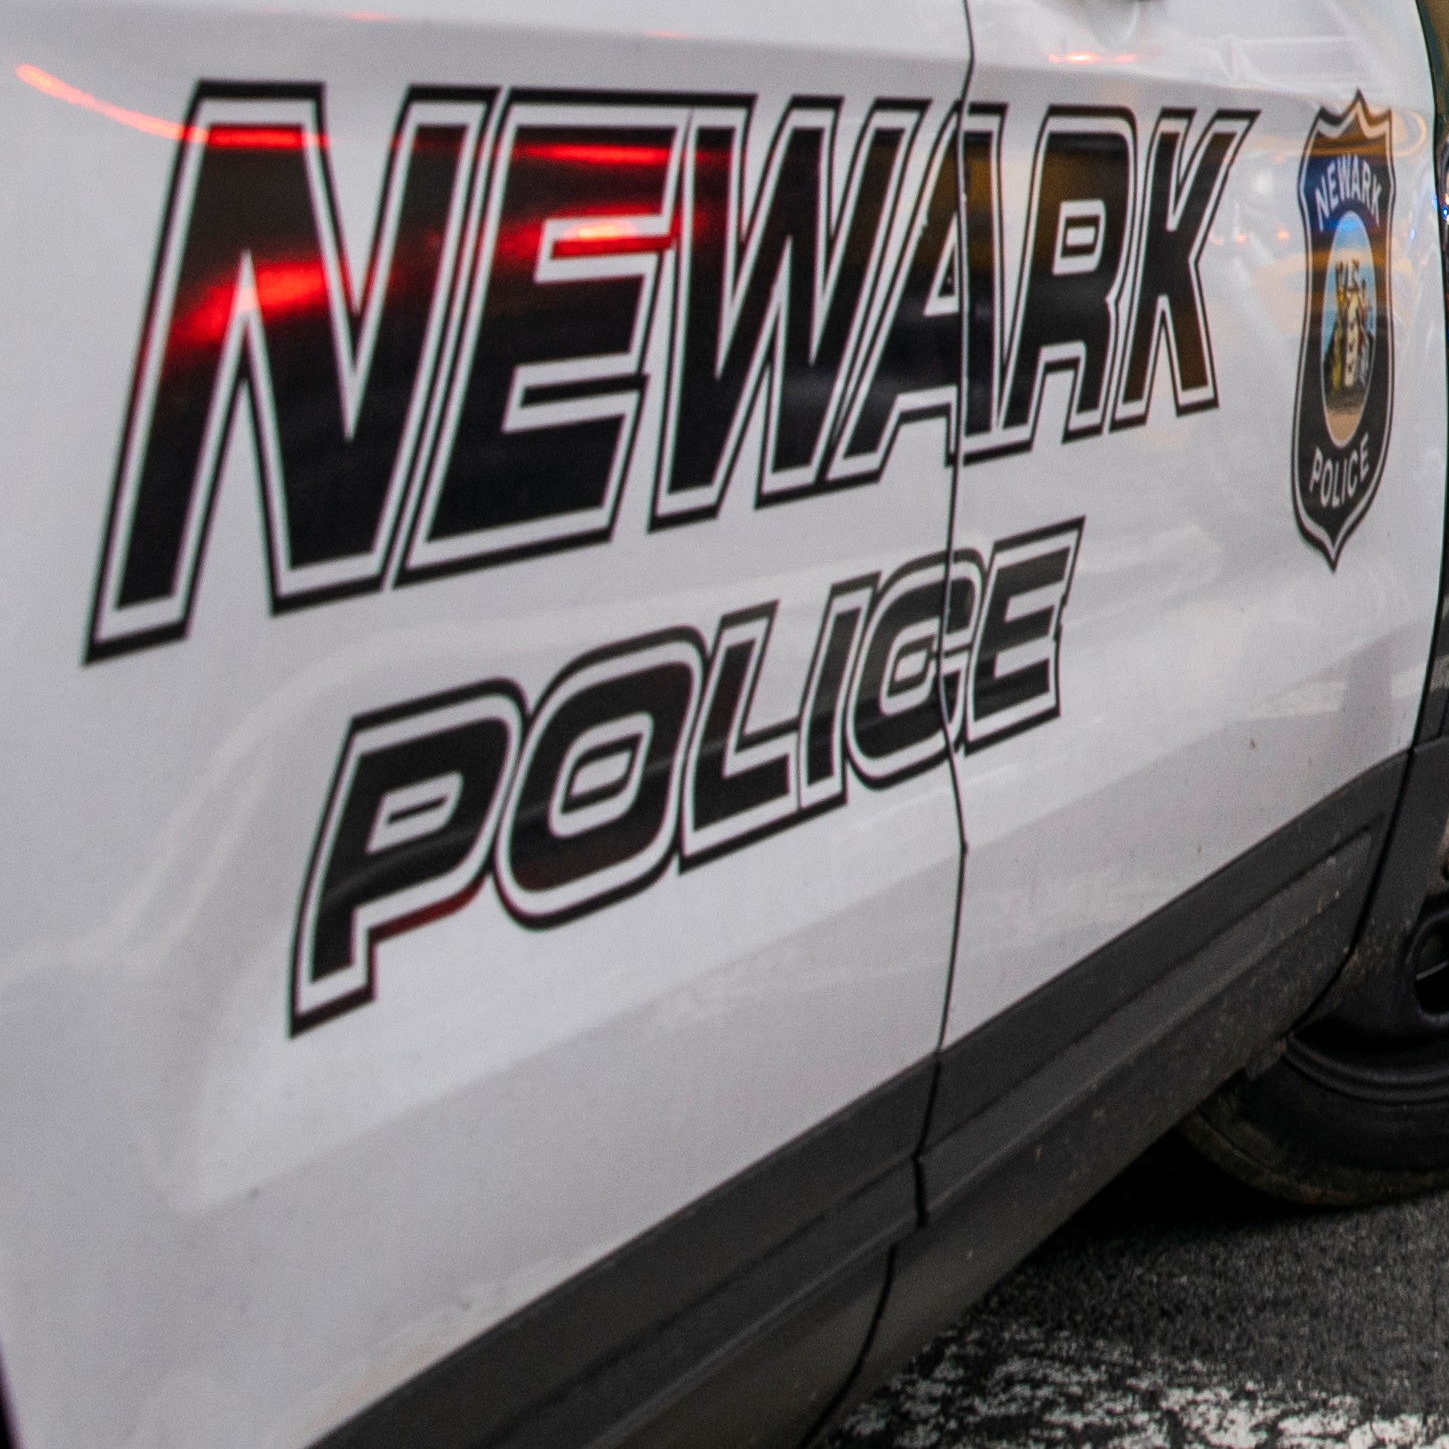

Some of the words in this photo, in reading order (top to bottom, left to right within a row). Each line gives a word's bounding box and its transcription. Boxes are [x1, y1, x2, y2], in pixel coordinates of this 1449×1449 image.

[1314, 153, 1382, 233] NEWARK
[82, 80, 1261, 668] NEWARK
[1308, 431, 1370, 509] POLICE
[287, 516, 1086, 1039] POLICE
